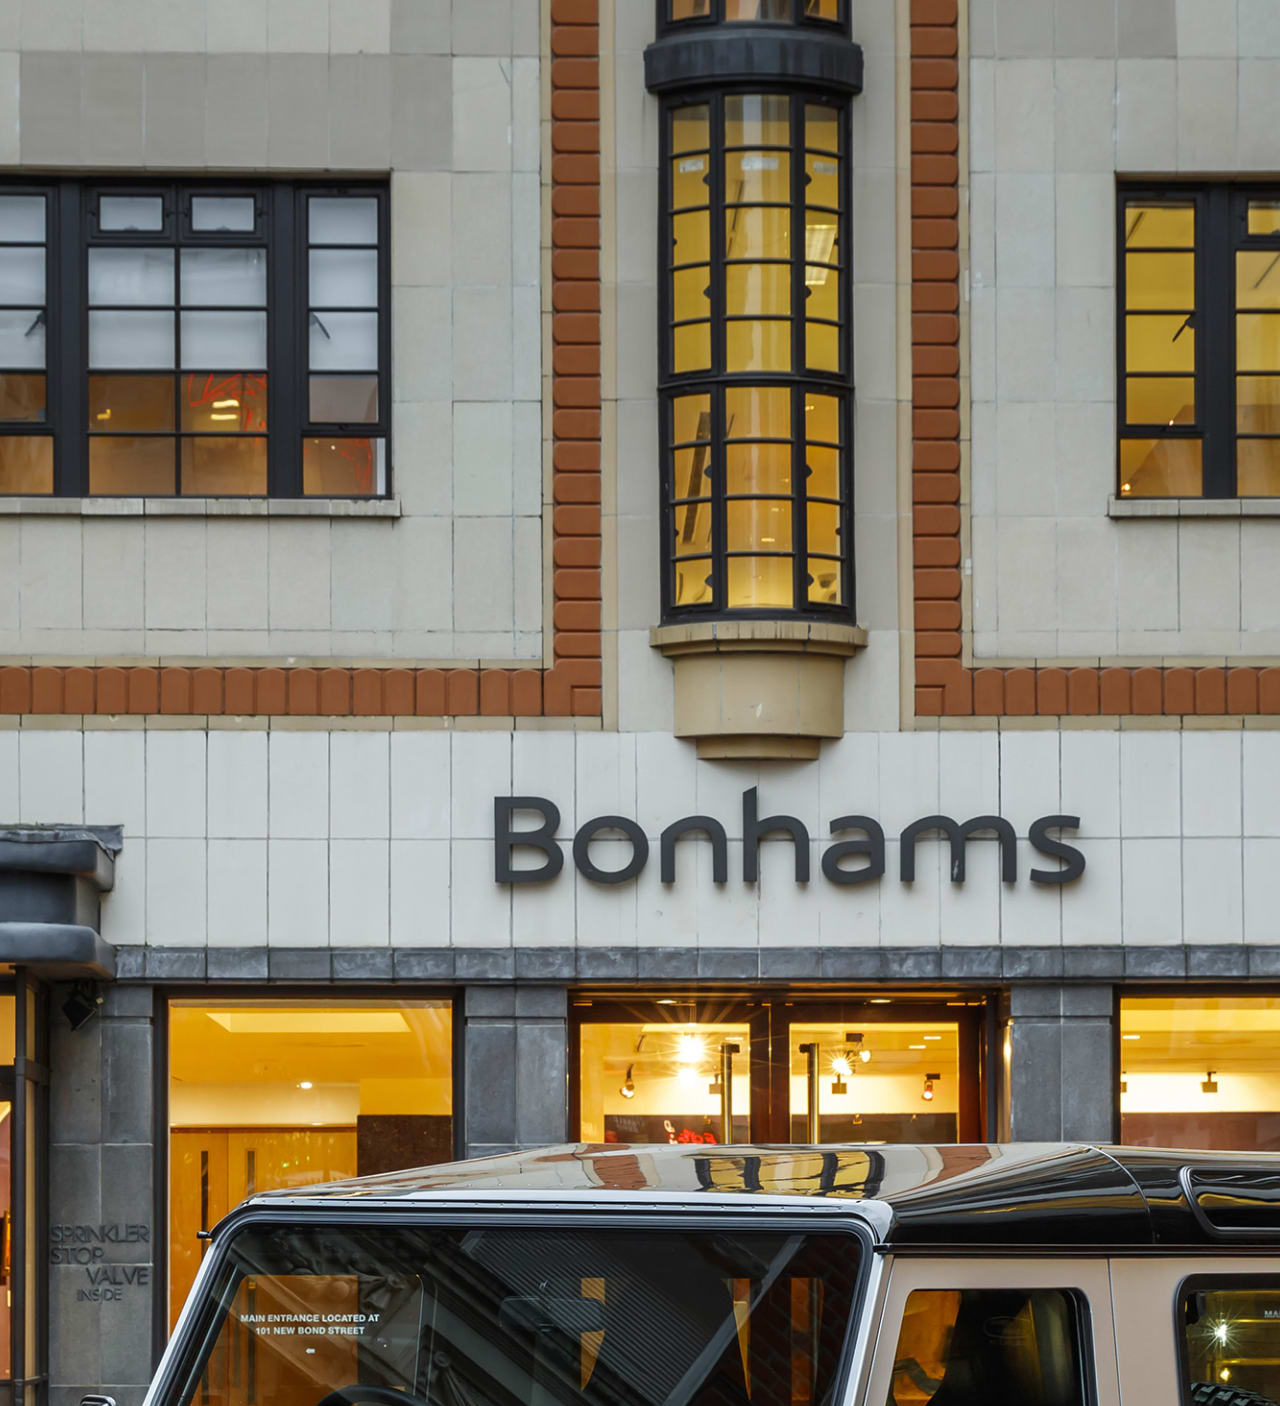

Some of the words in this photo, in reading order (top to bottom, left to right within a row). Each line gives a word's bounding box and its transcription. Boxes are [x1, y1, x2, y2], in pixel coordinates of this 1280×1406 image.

[493, 786, 1086, 886] Bonhams
[50, 1223, 150, 1243] SPRINKLER
[50, 1246, 104, 1265] STOP
[86, 1266, 149, 1286] VALVE
[240, 1314, 265, 1323] MAIN
[267, 1314, 319, 1322] ENTRANCE
[322, 1314, 366, 1322] LOCATED
[368, 1314, 380, 1322] AT
[256, 1327, 271, 1335] 101
[273, 1327, 295, 1335] NEW
[298, 1327, 326, 1335] BOND
[328, 1327, 365, 1335] STREET
